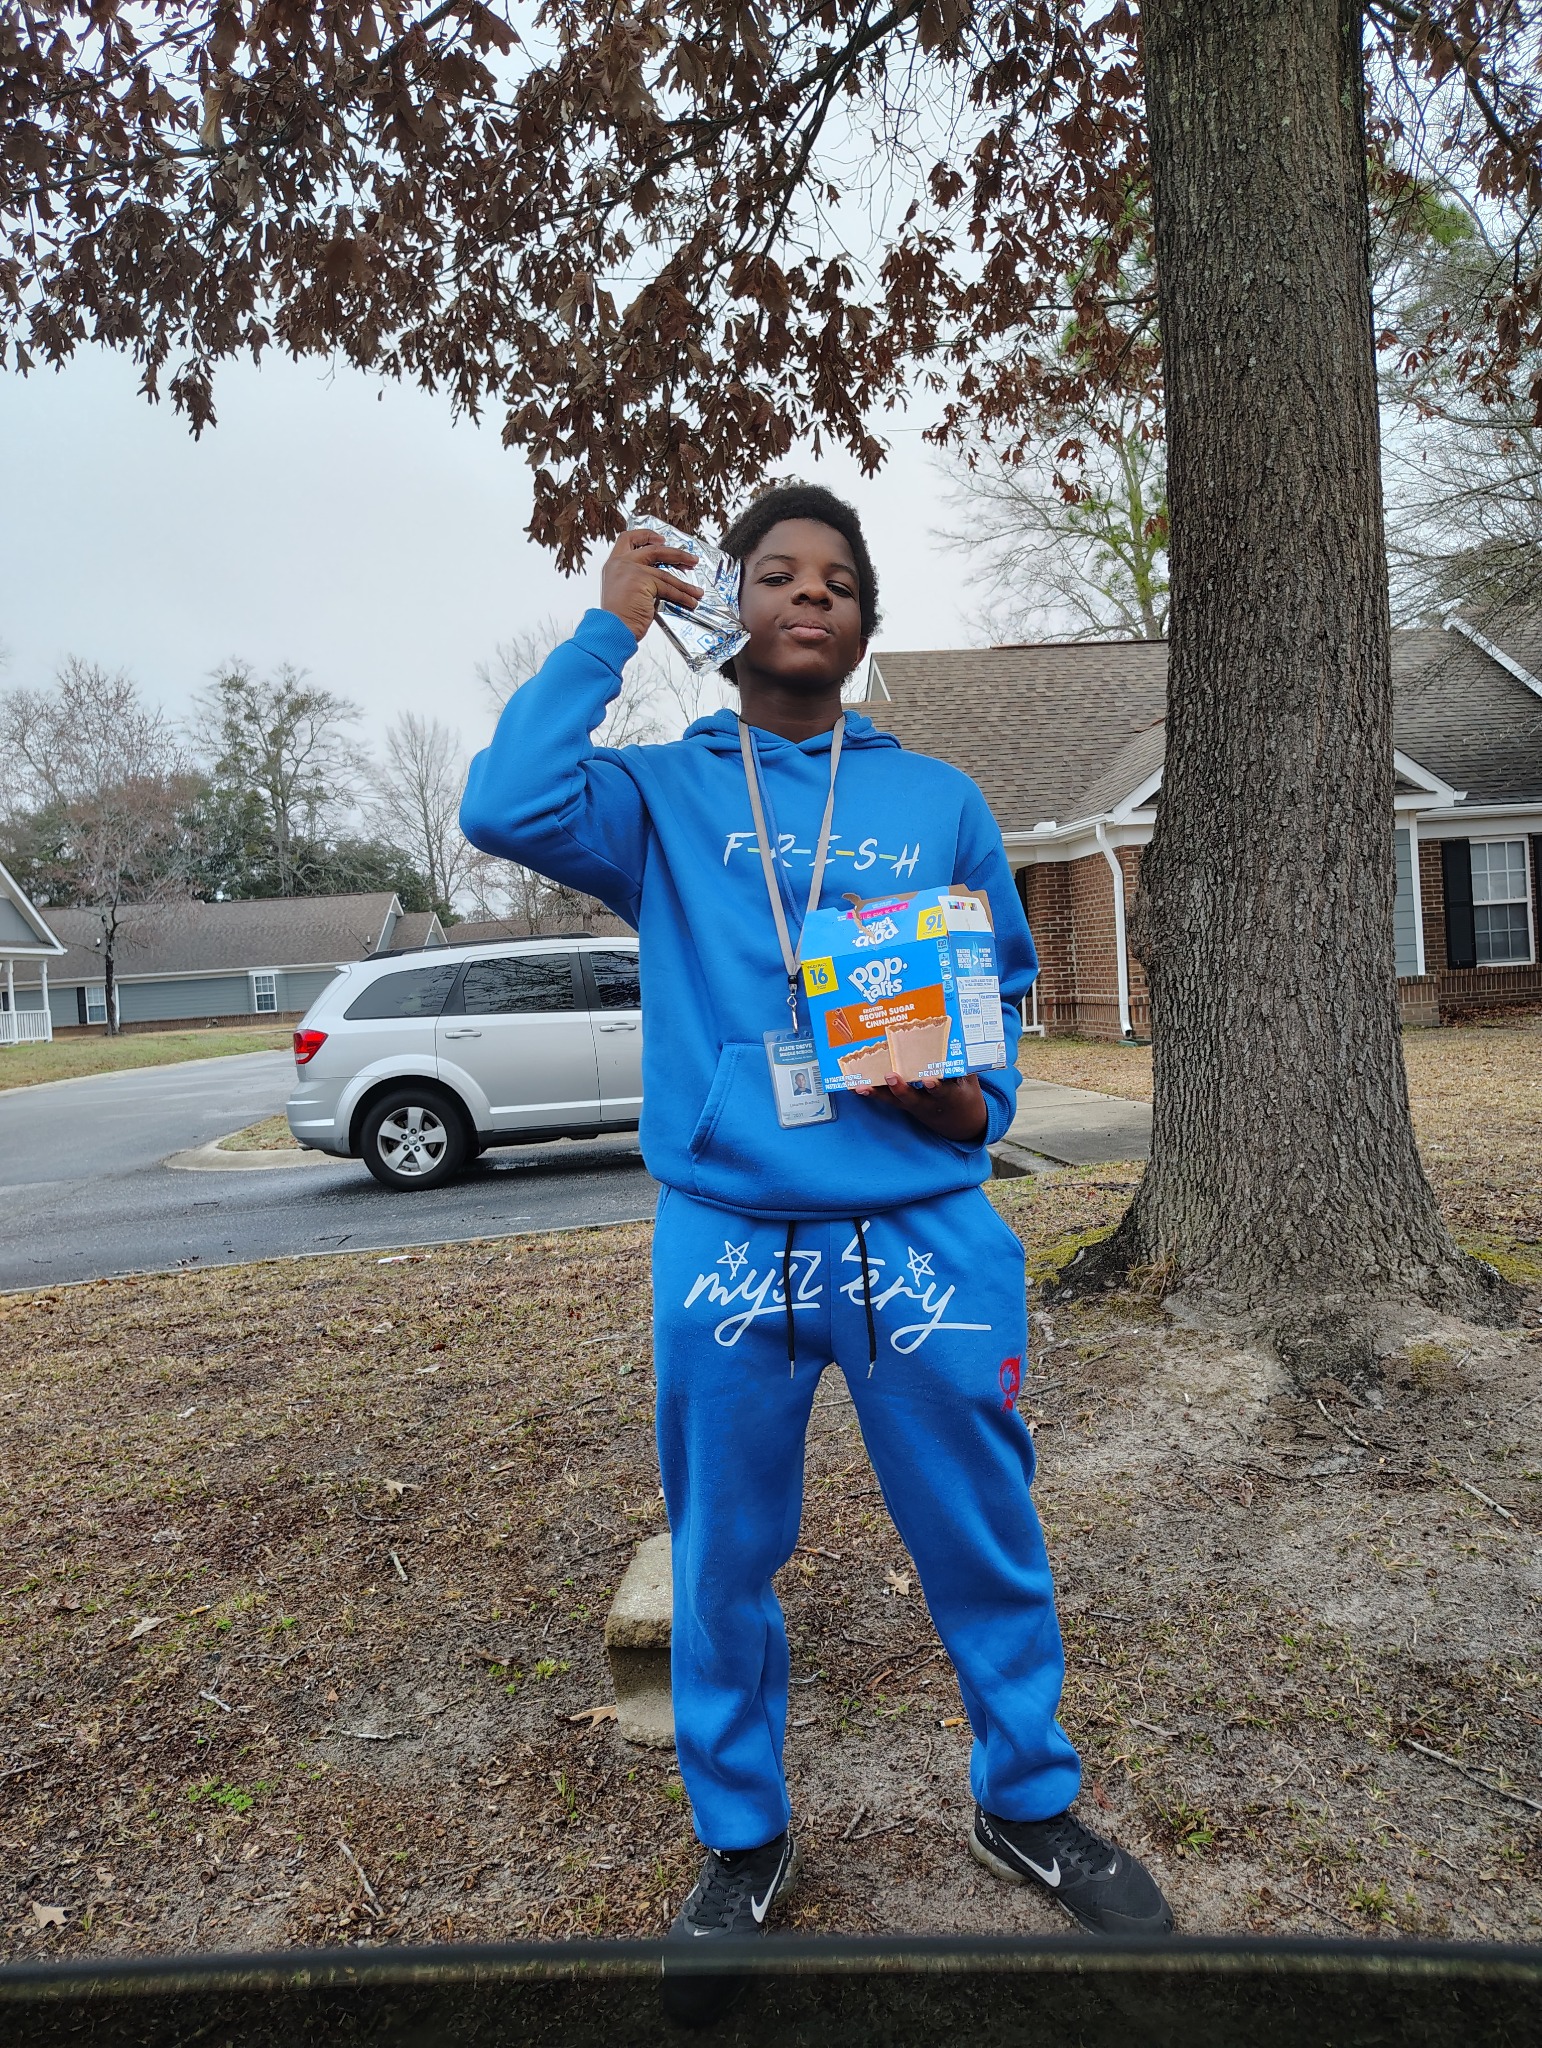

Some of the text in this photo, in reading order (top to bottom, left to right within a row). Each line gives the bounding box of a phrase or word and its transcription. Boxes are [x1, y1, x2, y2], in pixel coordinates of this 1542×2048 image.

[925, 914, 943, 931] 16
[810, 967, 829, 986] 16
[862, 979, 903, 1003] tarts
[859, 1003, 916, 1022] BROWN SUGAR
[865, 1013, 909, 1029] CINNAMON
